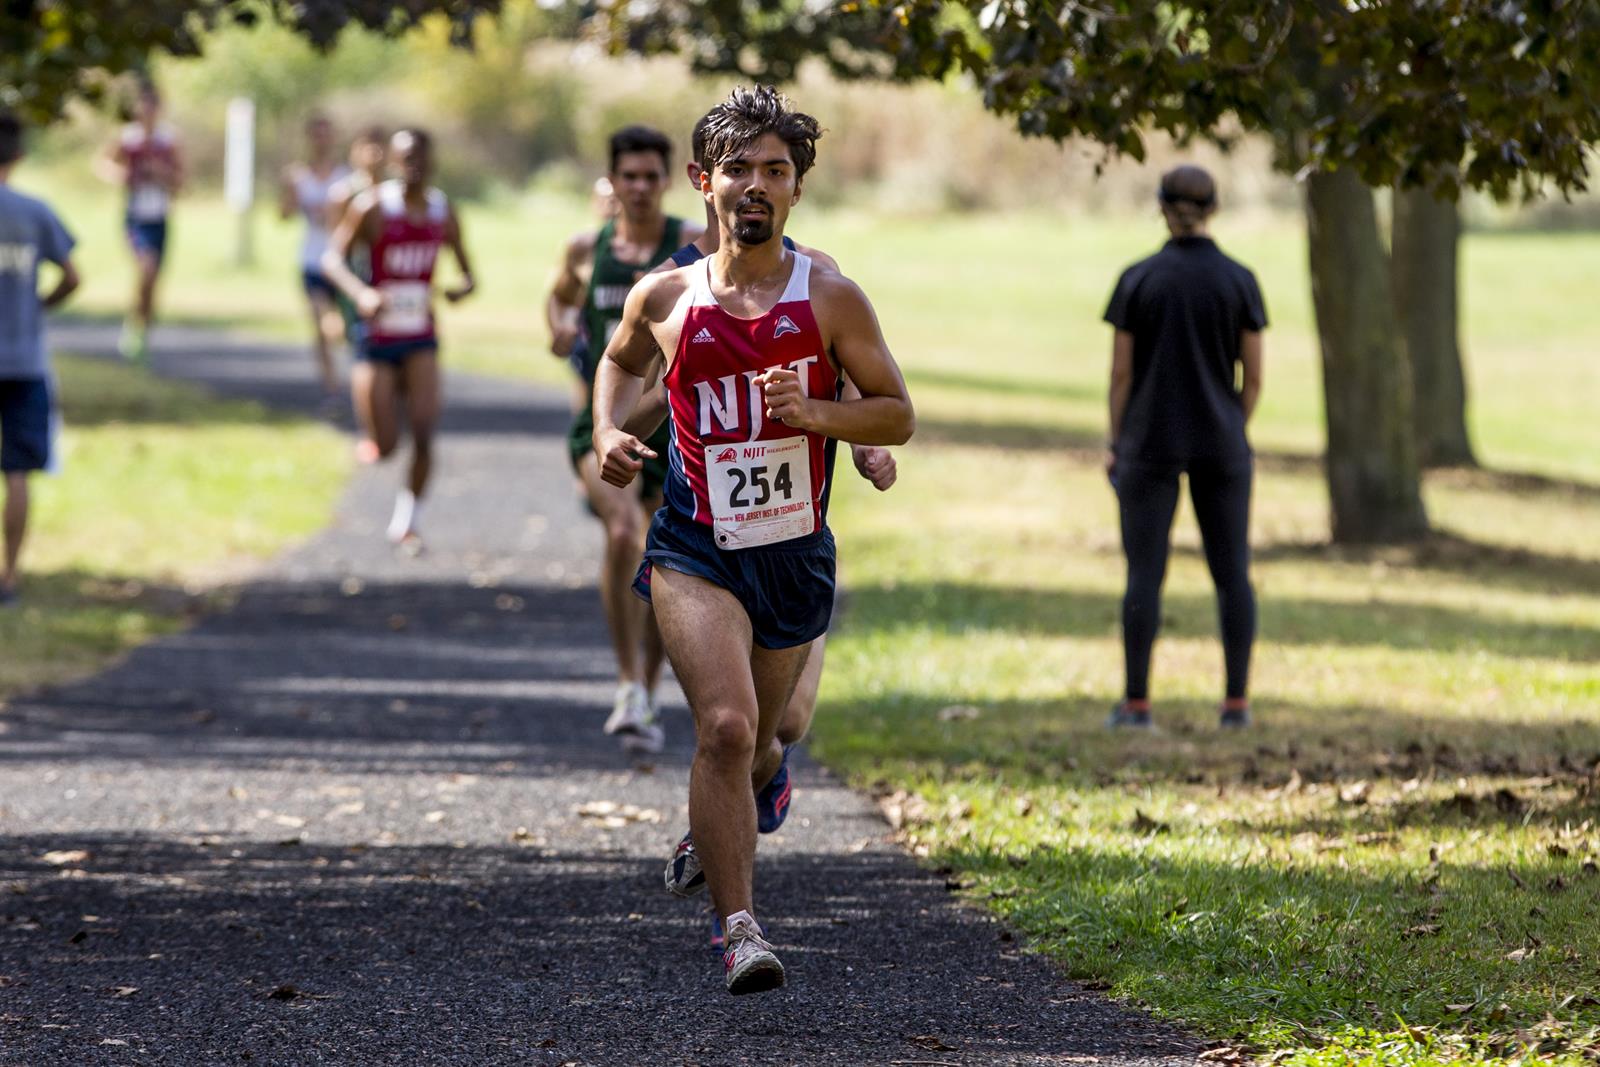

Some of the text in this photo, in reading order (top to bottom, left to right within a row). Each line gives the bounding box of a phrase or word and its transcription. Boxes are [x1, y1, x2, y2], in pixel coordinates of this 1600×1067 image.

[693, 355, 818, 444] NJT
[743, 447, 767, 460] NJIT
[726, 462, 793, 508] 254
[734, 514, 745, 522] NEW
[746, 511, 762, 521] JERSEY
[762, 509, 773, 519] INST.
[773, 507, 780, 516] OF
[780, 502, 805, 515] TECHNOLOGY
